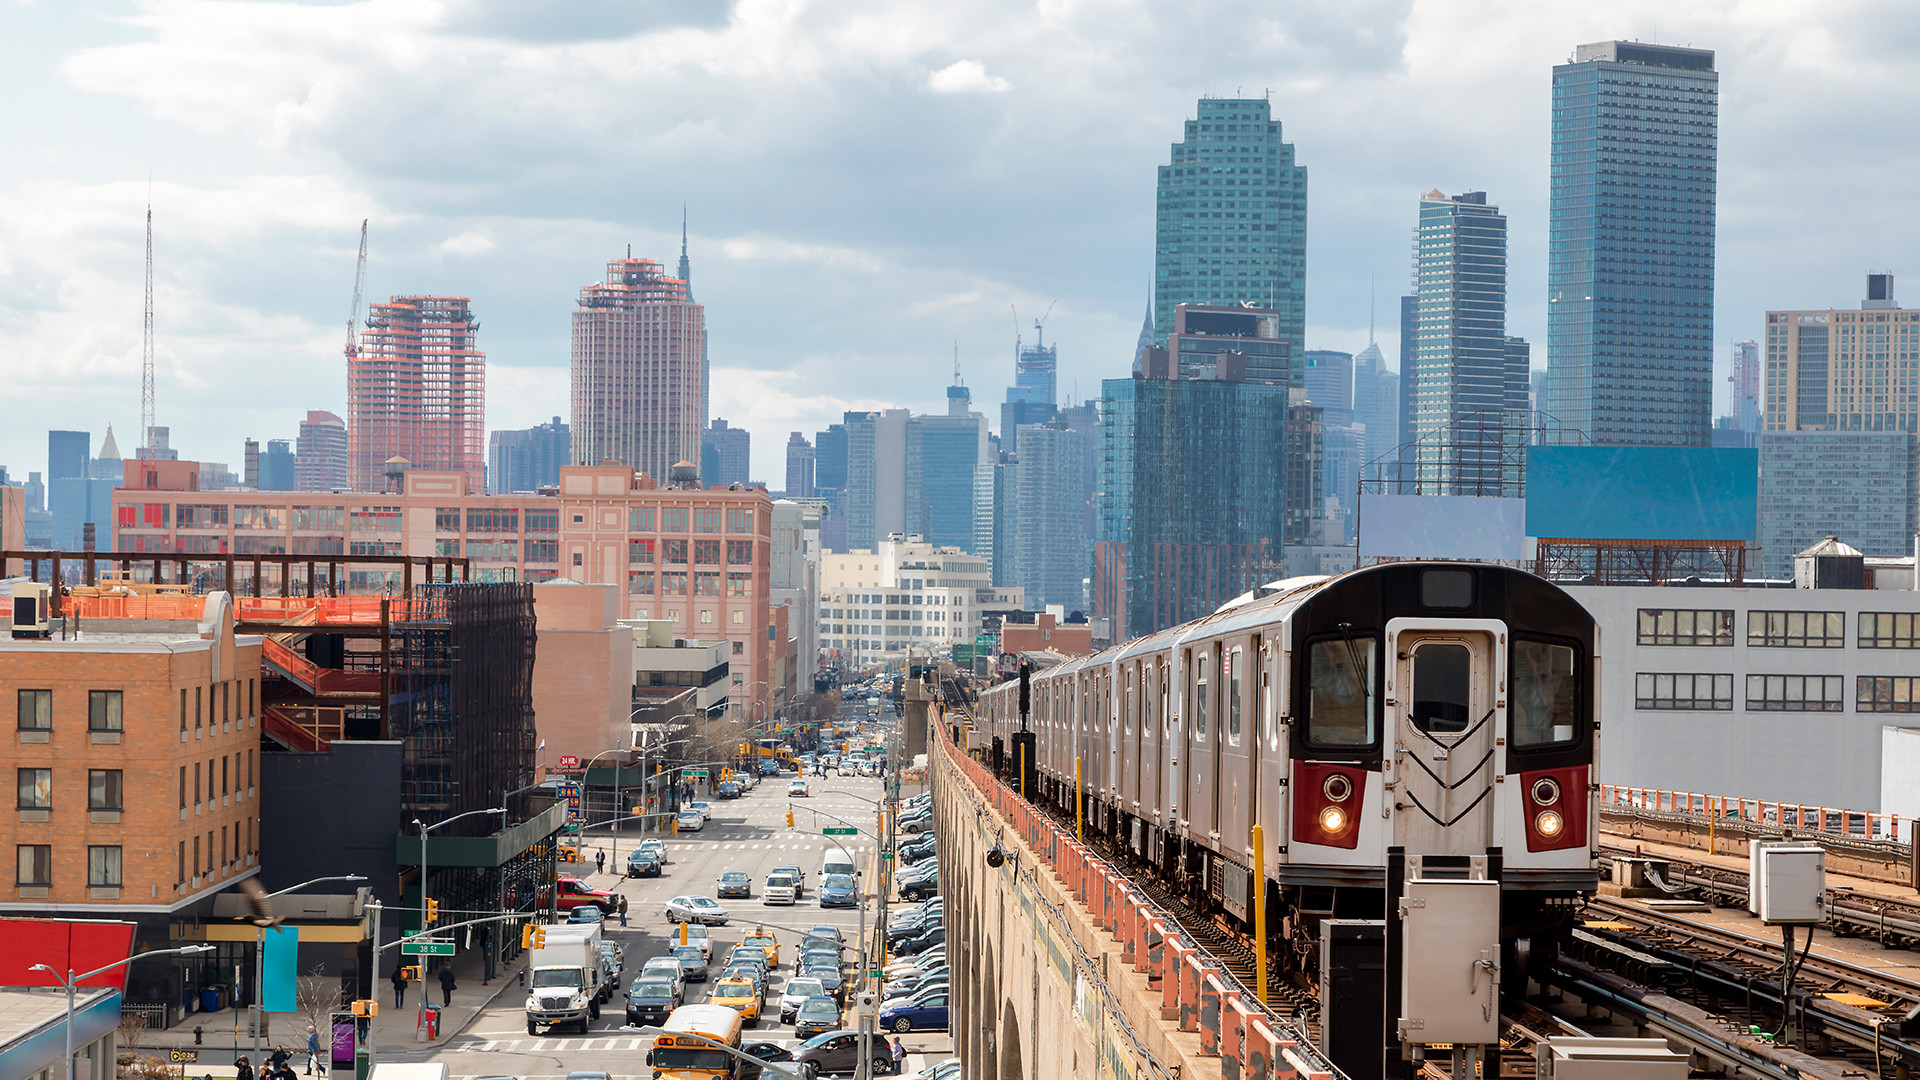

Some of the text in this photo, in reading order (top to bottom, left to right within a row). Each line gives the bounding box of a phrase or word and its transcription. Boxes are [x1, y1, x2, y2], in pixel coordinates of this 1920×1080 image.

[562, 757, 576, 765] 24 HR
[561, 788, 577, 797] CAR
[569, 797, 579, 807] SH
[419, 945, 437, 953] 38 St
